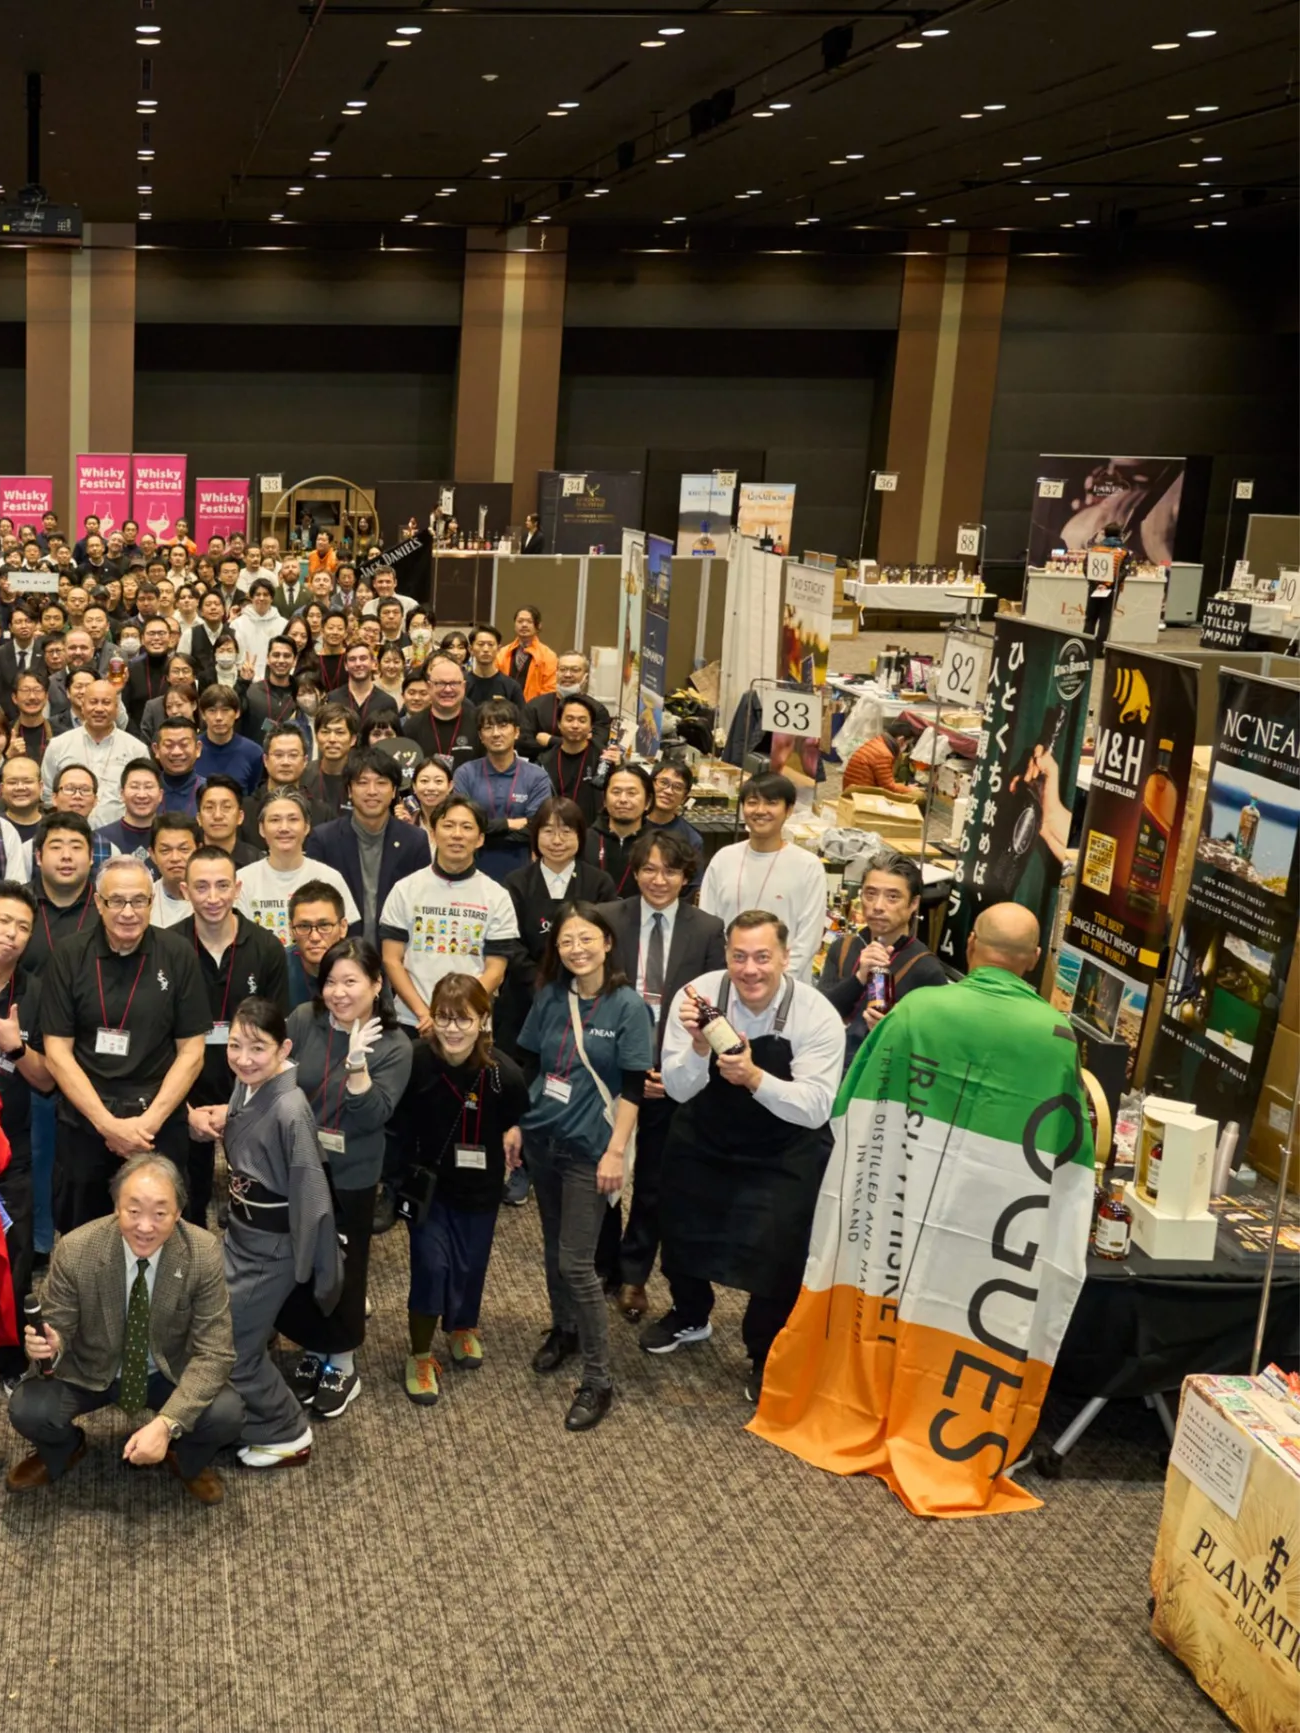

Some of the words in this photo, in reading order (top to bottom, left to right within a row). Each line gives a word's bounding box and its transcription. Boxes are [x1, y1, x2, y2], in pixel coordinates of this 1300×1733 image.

[80, 467, 125, 480] Whisky
[137, 468, 181, 480] Whisky
[720, 475, 733, 486] 35
[80, 478, 126, 489] Festival
[136, 479, 182, 490] Festival
[264, 479, 279, 491] 33
[566, 480, 581, 492] 34
[878, 478, 893, 489] 36
[1043, 484, 1060, 496] 37
[1239, 486, 1250, 496] 38
[3, 490, 48, 502] Whisky
[200, 492, 244, 504] Whisky
[2, 501, 48, 511] Festival
[200, 503, 244, 514] Festival
[960, 534, 975, 552] 88
[360, 560, 382, 578] JACK
[1092, 558, 1108, 577] 89
[1281, 578, 1296, 601] 90
[947, 652, 976, 696] 82
[773, 700, 810, 730] 83
[1224, 708, 1300, 759] NC'NEA
[1220, 742, 1246, 757] ORGANIC
[1248, 751, 1272, 764] WHISKY
[1105, 781, 1137, 800] DISTILLERY
[260, 900, 284, 908] TURTLE
[1218, 882, 1246, 898] RENEWABLE
[1246, 894, 1266, 908] ENERGY
[422, 906, 446, 916] TURTLE
[448, 907, 461, 917] ALL
[462, 909, 488, 921] STARS!
[1204, 889, 1230, 905] ORGANIC
[1230, 900, 1253, 917] SCOTTISH
[1254, 912, 1275, 926] BARLEY
[1094, 911, 1107, 927] THE
[1108, 918, 1124, 935] BEST
[1196, 899, 1222, 914] RECYCLED
[1223, 910, 1238, 924] GLASS
[1238, 919, 1257, 932] WHISKY
[1258, 928, 1282, 943] BOTTLE
[1072, 916, 1096, 936] SINGLE
[1096, 925, 1114, 944] MALT
[1114, 935, 1138, 958] WHISKY
[1091, 938, 1104, 954] THE
[1104, 945, 1127, 967] WORLD
[1161, 1024, 1175, 1038] MADE
[1176, 1034, 1184, 1042] BY
[1185, 1039, 1208, 1058] NATURE,
[1208, 1053, 1220, 1065] NOT
[1220, 1061, 1228, 1070] BY
[1229, 1066, 1247, 1082] RULES
[876, 1046, 894, 1105] TRIPLE
[856, 1144, 868, 1163] IN
[867, 1114, 887, 1204] DISTILLED
[862, 1211, 875, 1250] AND
[1234, 1612, 1264, 1654] RUM
